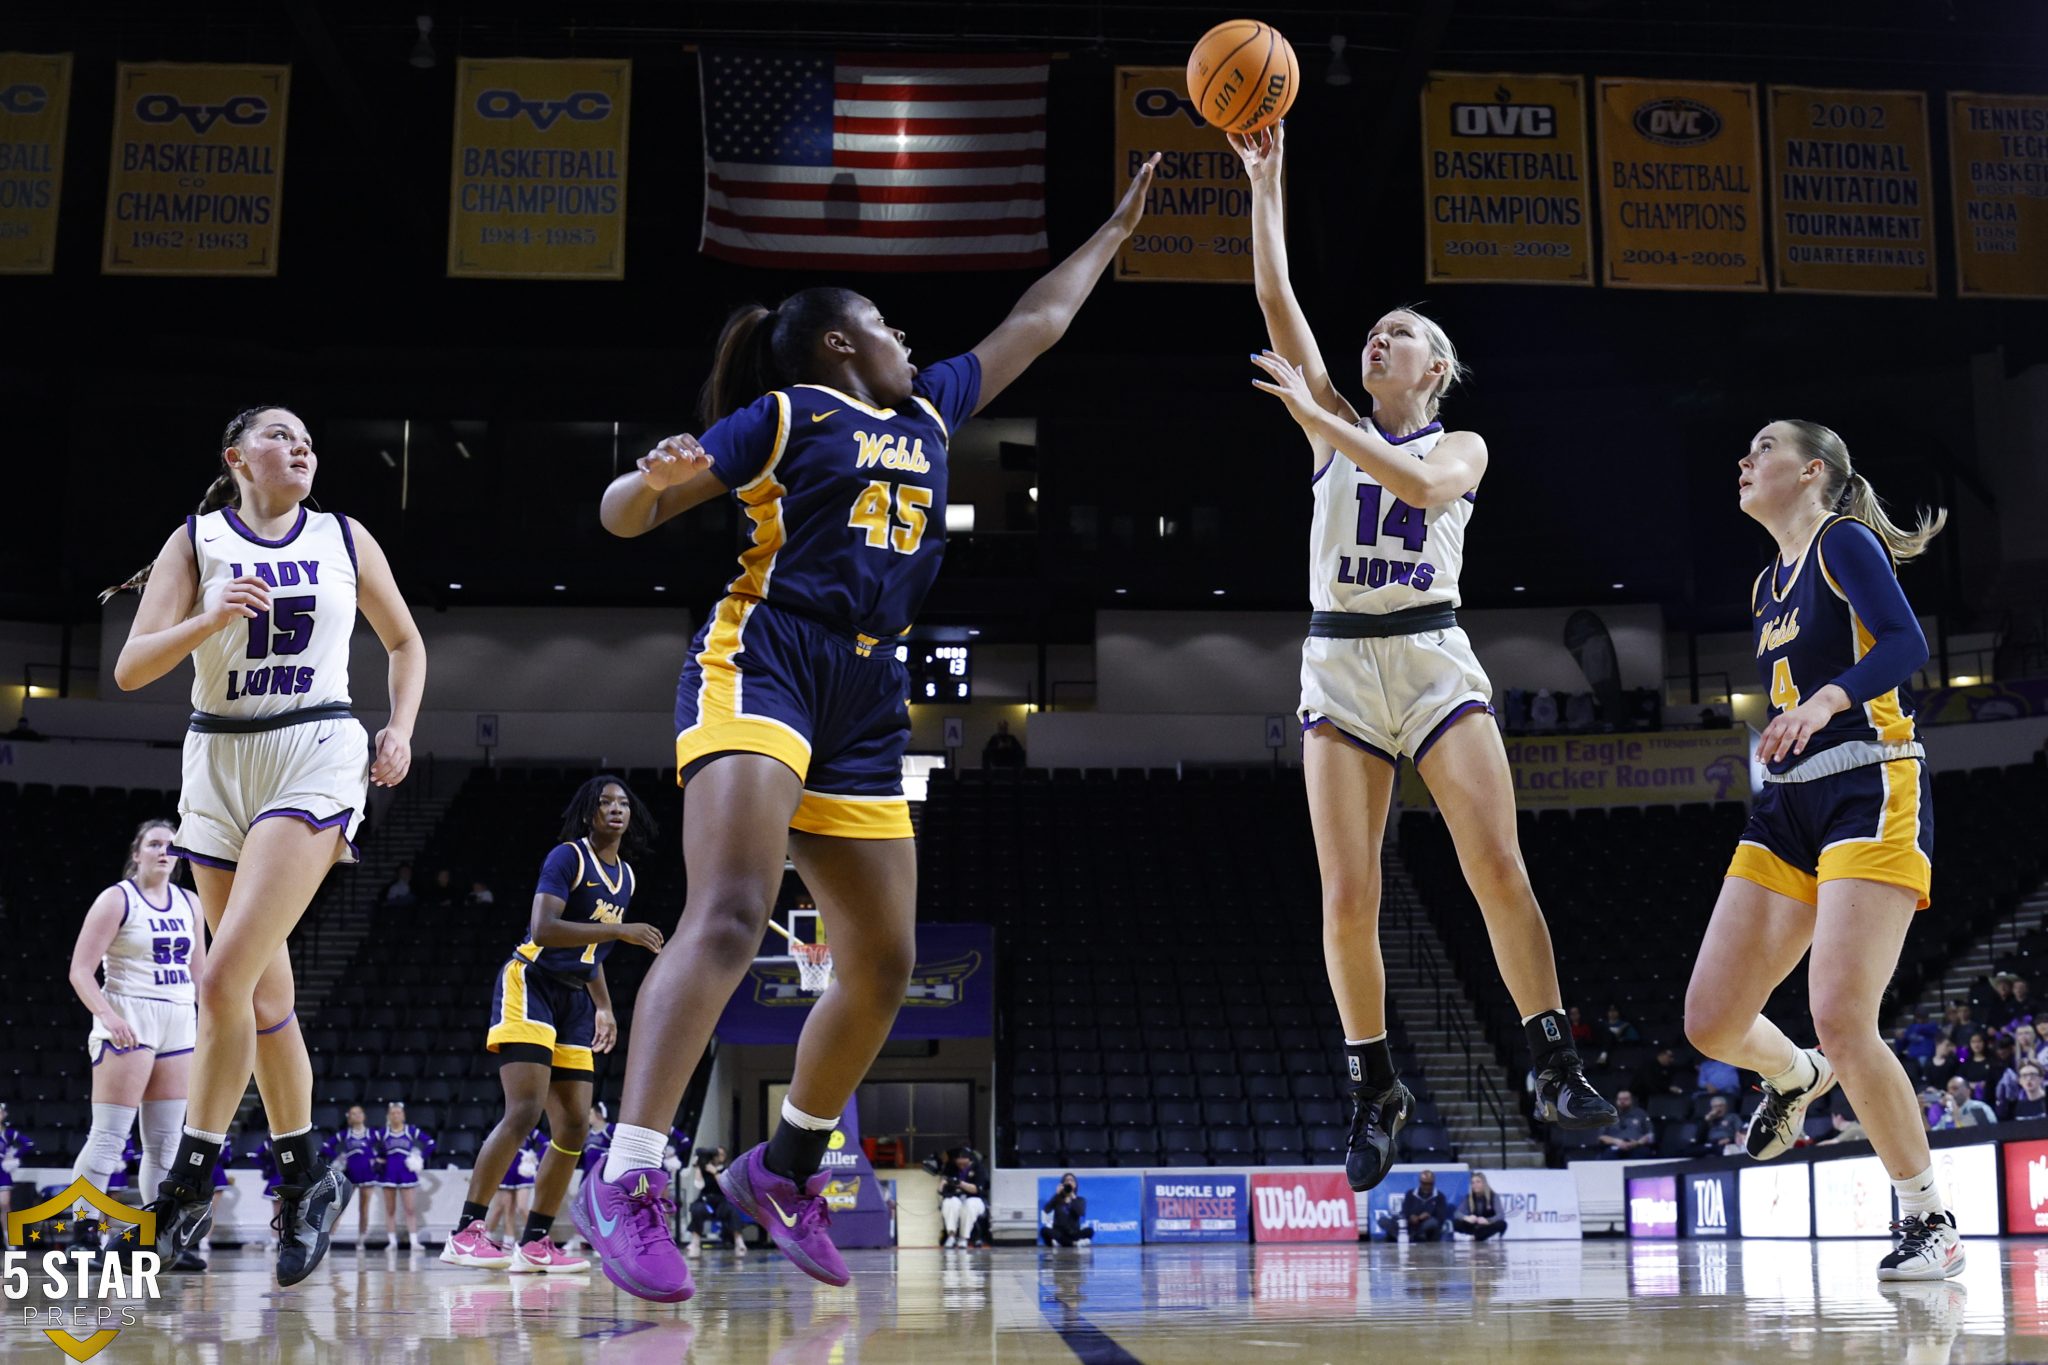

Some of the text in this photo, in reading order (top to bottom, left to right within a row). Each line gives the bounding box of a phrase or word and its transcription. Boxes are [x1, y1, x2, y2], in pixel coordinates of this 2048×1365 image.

[136, 94, 267, 134] OVC
[476, 90, 611, 131] OVC
[1135, 90, 1206, 126] OV
[1456, 105, 1554, 136] OVC
[1650, 109, 1702, 135] OVC
[1812, 103, 1885, 129] 2002
[1967, 107, 2048, 131] TENNES
[0, 143, 52, 173] BALL
[123, 143, 274, 174] BASKETBALL
[463, 148, 618, 179] BASKETBALL
[1434, 151, 1578, 181] BASKETBALL
[1787, 140, 1911, 172] NATIONAL
[1613, 161, 1749, 193] BASKETBALL
[1783, 174, 1918, 206] INVITATION
[0, 178, 50, 209] ONS
[116, 193, 270, 225] CHAMPIONS
[461, 183, 617, 214] CHAMPIONS
[1434, 195, 1581, 226] CHAMPIONS
[1620, 201, 1746, 231] CHAMPIONS
[1785, 212, 1921, 240] TOURNAMENT
[1967, 201, 2017, 221] NCAA
[1789, 246, 1926, 266] QUARTERFINALS
[853, 430, 931, 474] Webb
[847, 479, 933, 556] 45
[1355, 482, 1428, 553] 14
[1337, 555, 1436, 592] LIONS
[243, 594, 317, 660] 15
[226, 665, 316, 701] LIONS
[1769, 655, 1801, 712] 4
[1566, 739, 1643, 766] Eagle
[1516, 764, 1696, 789] Locker Room
[147, 918, 187, 932] LADY
[152, 936, 191, 965] 52
[153, 969, 189, 985] LION
[1155, 1185, 1237, 1198] BUCKLE UP
[1693, 1178, 1728, 1228] TOA
[1156, 1198, 1237, 1219] TENNESSEE
[1255, 1185, 1353, 1230] Wilson
